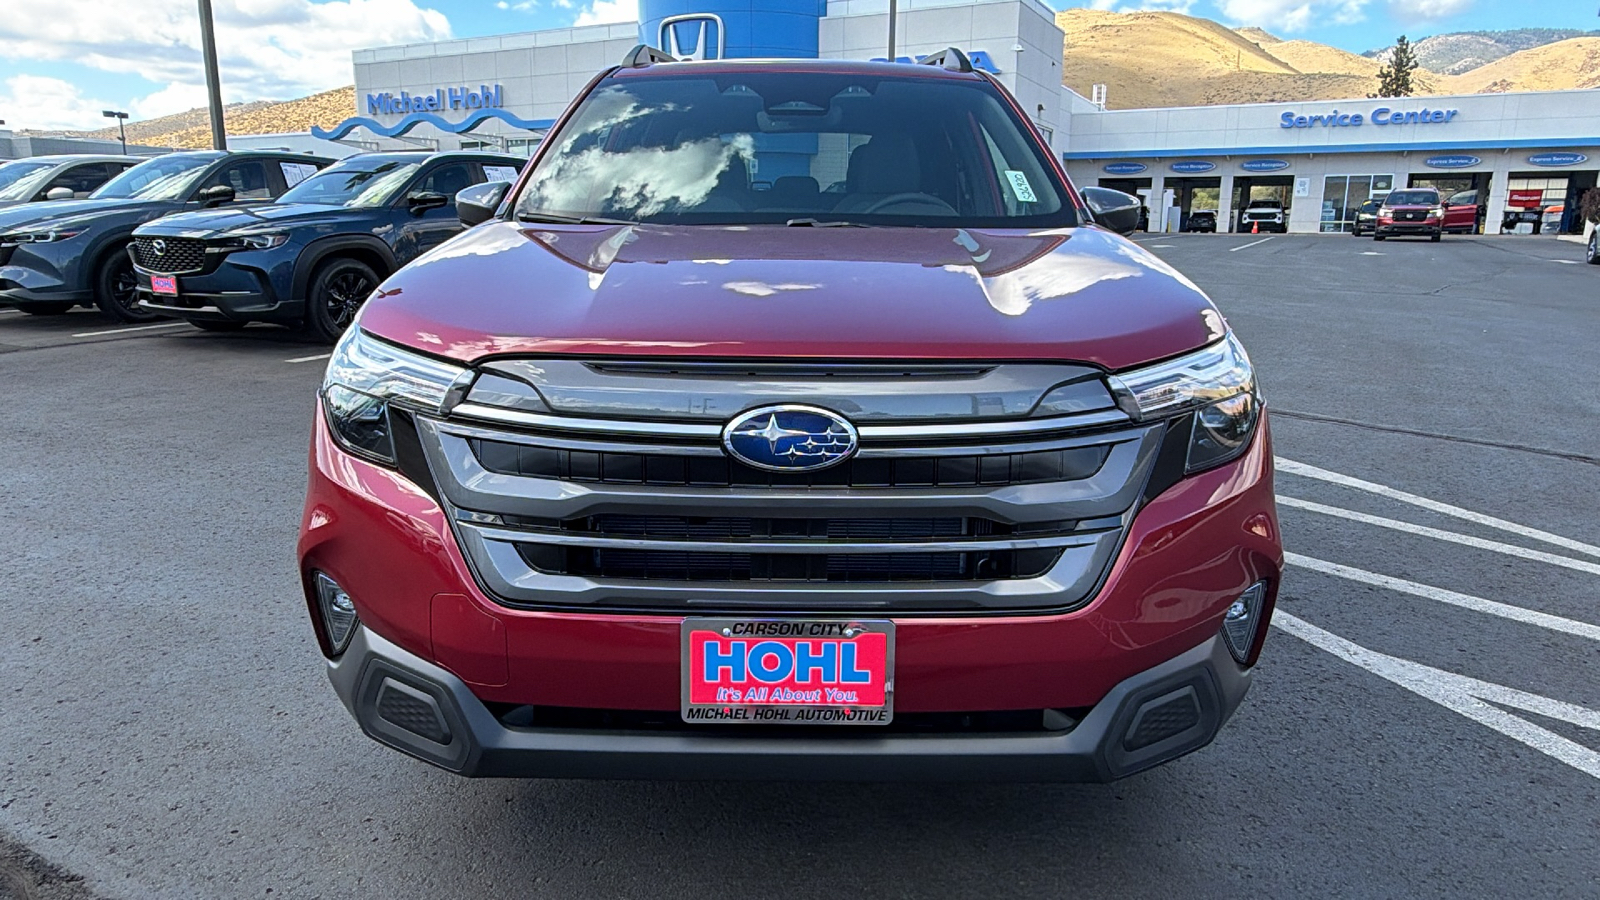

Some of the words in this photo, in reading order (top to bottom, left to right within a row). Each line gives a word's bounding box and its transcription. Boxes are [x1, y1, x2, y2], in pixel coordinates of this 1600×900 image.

[367, 89, 442, 114] Michael
[448, 84, 502, 109] Hohl
[1280, 110, 1363, 128] Service
[1371, 107, 1457, 125] Center
[732, 622, 805, 636] CARSON
[808, 623, 848, 636] CITY
[704, 641, 870, 683] HOHL
[716, 687, 742, 701] It's
[744, 687, 768, 701] All
[770, 687, 822, 701] About
[825, 687, 859, 702] You.
[686, 707, 749, 720] MICHAEL
[753, 708, 791, 721] HOHL
[793, 709, 888, 722] AUTOMOTIVE
